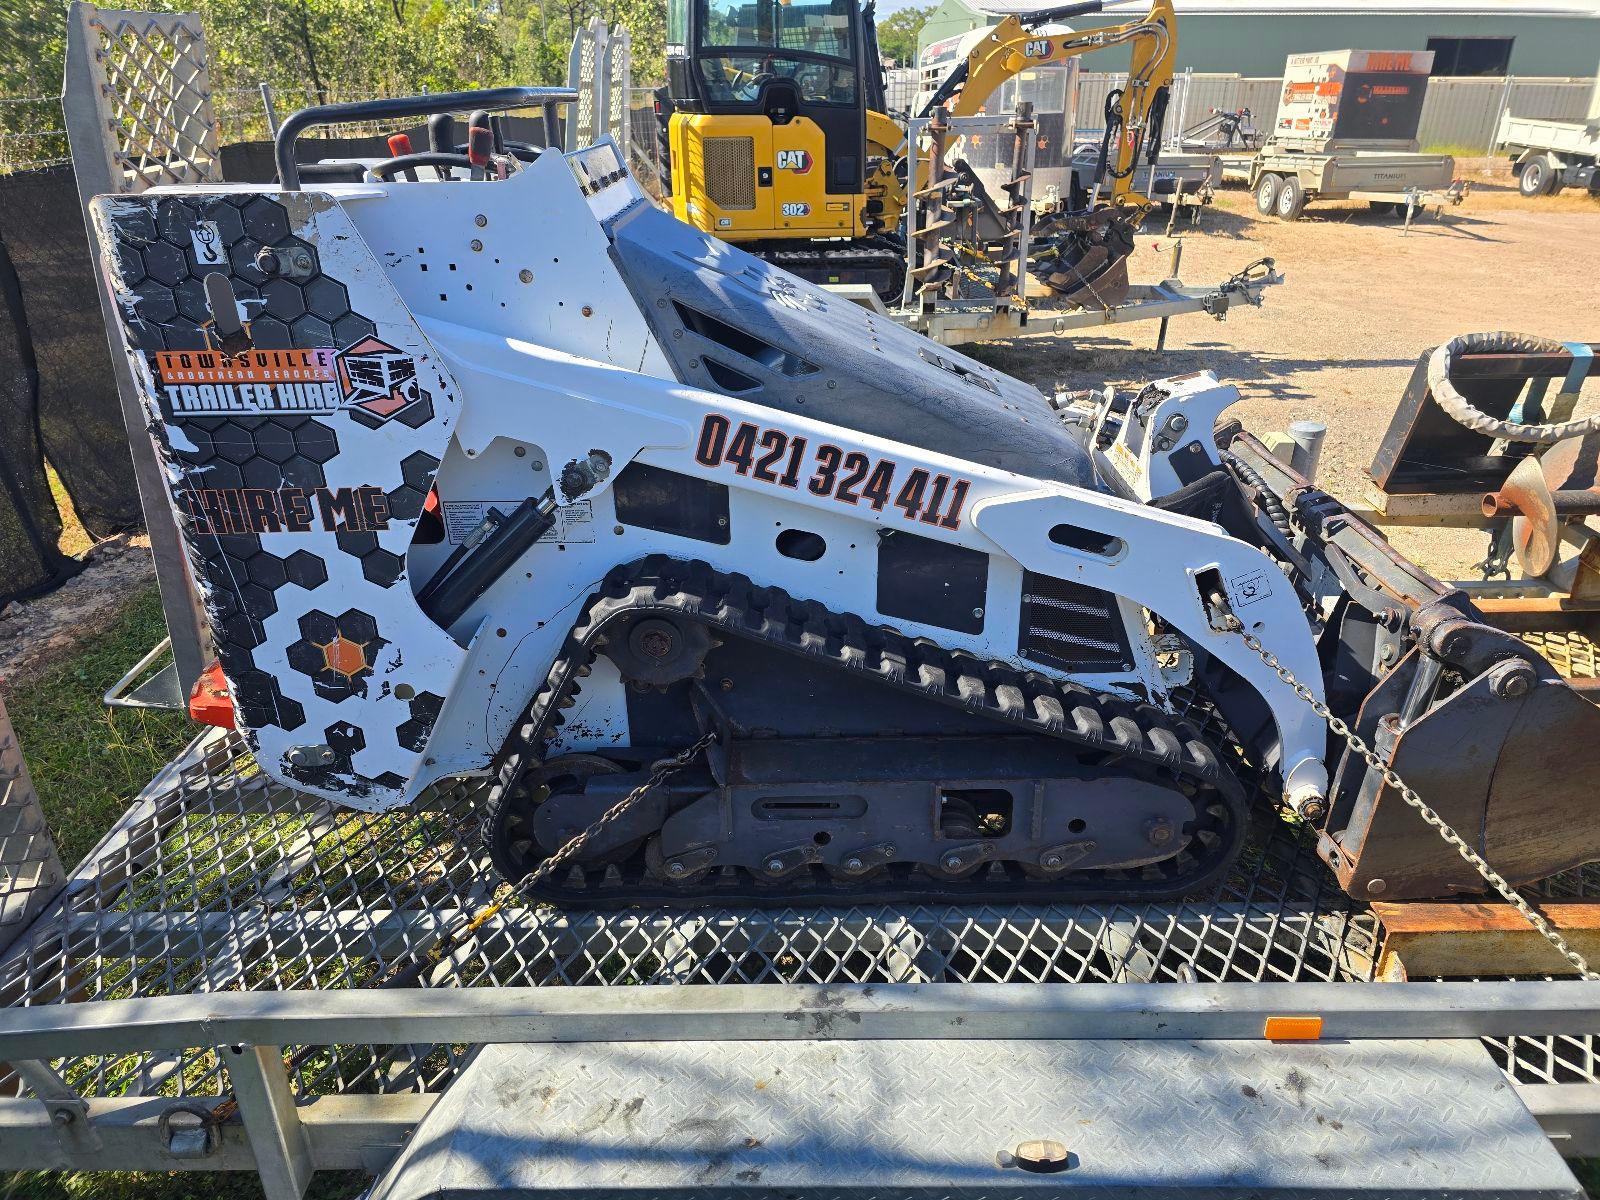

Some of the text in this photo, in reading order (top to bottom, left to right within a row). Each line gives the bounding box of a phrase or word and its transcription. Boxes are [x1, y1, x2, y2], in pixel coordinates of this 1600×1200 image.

[1025, 40, 1048, 57] CAT
[777, 151, 804, 169] CAT
[782, 203, 805, 215] 302
[162, 352, 328, 369] TOWNSVILLE
[164, 382, 339, 411] TRAILER HIRE
[695, 413, 972, 531] 0421 324 411
[187, 488, 312, 534] HIRE
[314, 486, 390, 532] ME
